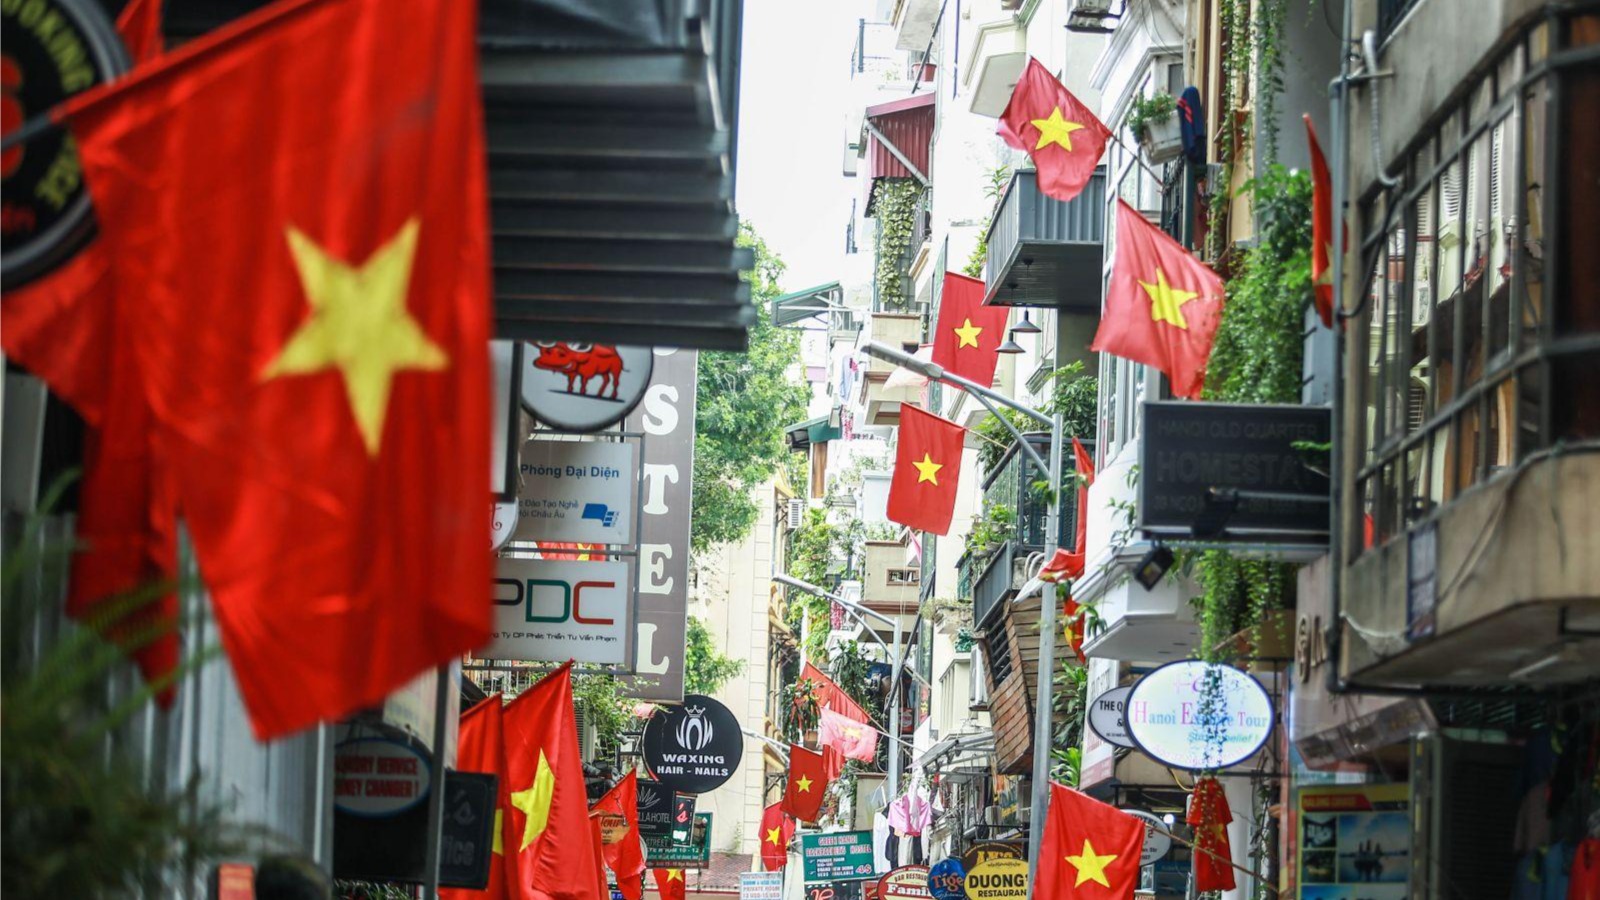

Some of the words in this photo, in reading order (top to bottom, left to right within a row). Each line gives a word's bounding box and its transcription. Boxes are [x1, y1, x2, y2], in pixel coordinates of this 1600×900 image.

[1210, 420, 1240, 439] OLD
[1243, 421, 1318, 440] QUARTER
[520, 464, 562, 479] Phòng
[566, 465, 587, 479] Đại
[591, 466, 620, 481] Diện
[1155, 450, 1310, 486] HOMESTA
[636, 347, 680, 675] STEL
[1099, 700, 1115, 711] THE
[1133, 701, 1176, 724] Hanoi
[1237, 712, 1268, 728] Tour
[376, 756, 418, 775] SERVICE
[662, 753, 725, 764] WAXING
[657, 765, 684, 774] HAIR
[694, 767, 729, 777] NAILS
[365, 779, 412, 798] CHANGER
[651, 812, 671, 823] HOTEL
[818, 835, 838, 846] GREEN
[849, 843, 872, 855] HOSTEL
[906, 873, 928, 881] RESTAUR
[931, 872, 965, 892] Tige
[968, 873, 1028, 889] DUONG'
[977, 889, 1027, 898] RESTAURAN
